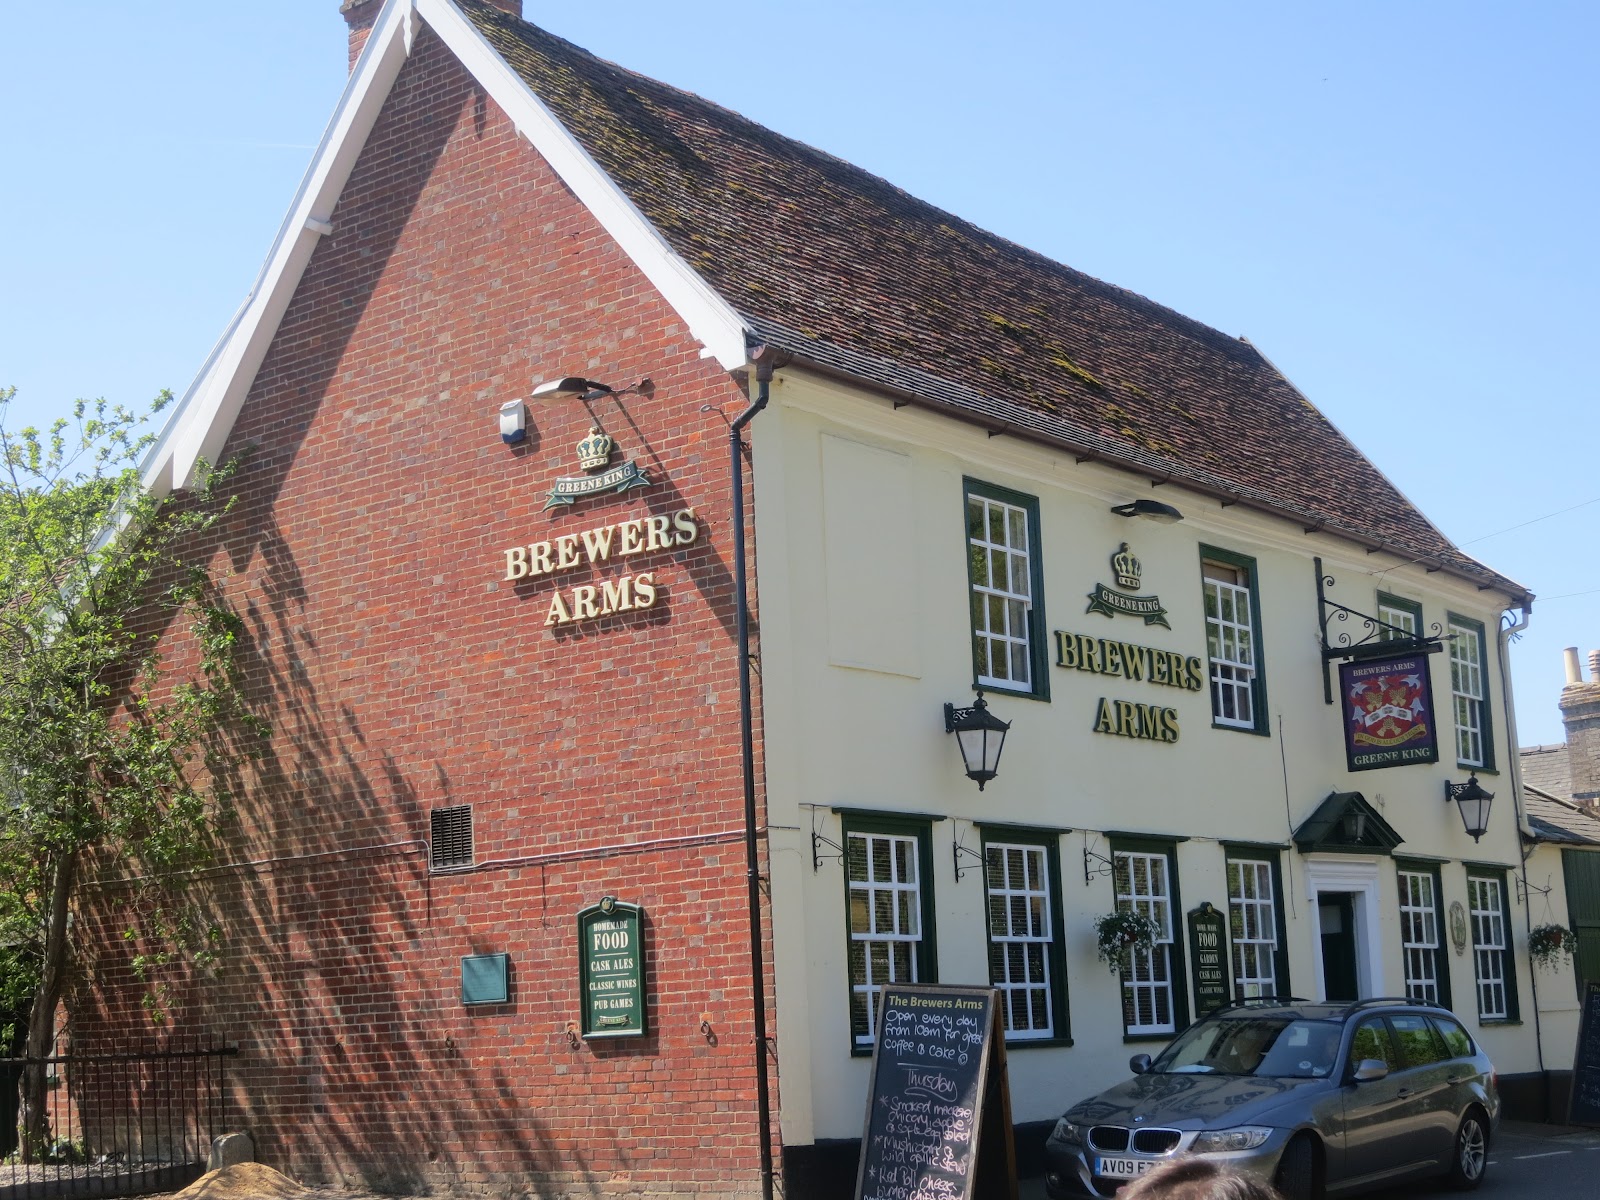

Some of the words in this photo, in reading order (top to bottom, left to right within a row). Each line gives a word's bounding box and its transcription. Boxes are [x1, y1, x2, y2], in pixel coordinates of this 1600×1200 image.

[557, 479, 602, 493] GREENE
[603, 467, 632, 485] KING
[503, 508, 699, 581] BREWERS
[543, 572, 657, 627] ARMS
[1102, 590, 1138, 611] GREENE
[1138, 600, 1159, 612] KING
[1054, 630, 1203, 691] BREWERS
[1353, 665, 1391, 677] BREWERS
[1393, 661, 1416, 671] ARMS
[1093, 697, 1181, 743] ARMS
[1354, 751, 1399, 765] GREENE
[1401, 747, 1430, 759] KING
[594, 931, 629, 951] FOOD
[1198, 933, 1217, 947] FOOD
[591, 960, 612, 972] CASK
[613, 958, 634, 970] ALES
[1199, 954, 1219, 964] GARDEN
[1199, 971, 1210, 980] CASK
[1211, 970, 1222, 980] ALES
[589, 981, 615, 991] CLASSIC
[616, 979, 637, 988] WINES
[594, 1000, 609, 1010] PUB
[610, 998, 634, 1009] GAMES
[889, 995, 908, 1007] The
[910, 996, 953, 1009] Brewers
[954, 998, 983, 1010] Arms
[885, 1009, 917, 1026] Open
[921, 1013, 953, 1032] every
[955, 1014, 978, 1036] day
[914, 1024, 941, 1038] 10am
[957, 1030, 983, 1054] great
[902, 1068, 958, 1100] Thursday
[890, 1096, 931, 1113] Smoked
[883, 1135, 940, 1156] Mushroom
[1101, 1159, 1134, 1174] AV09
